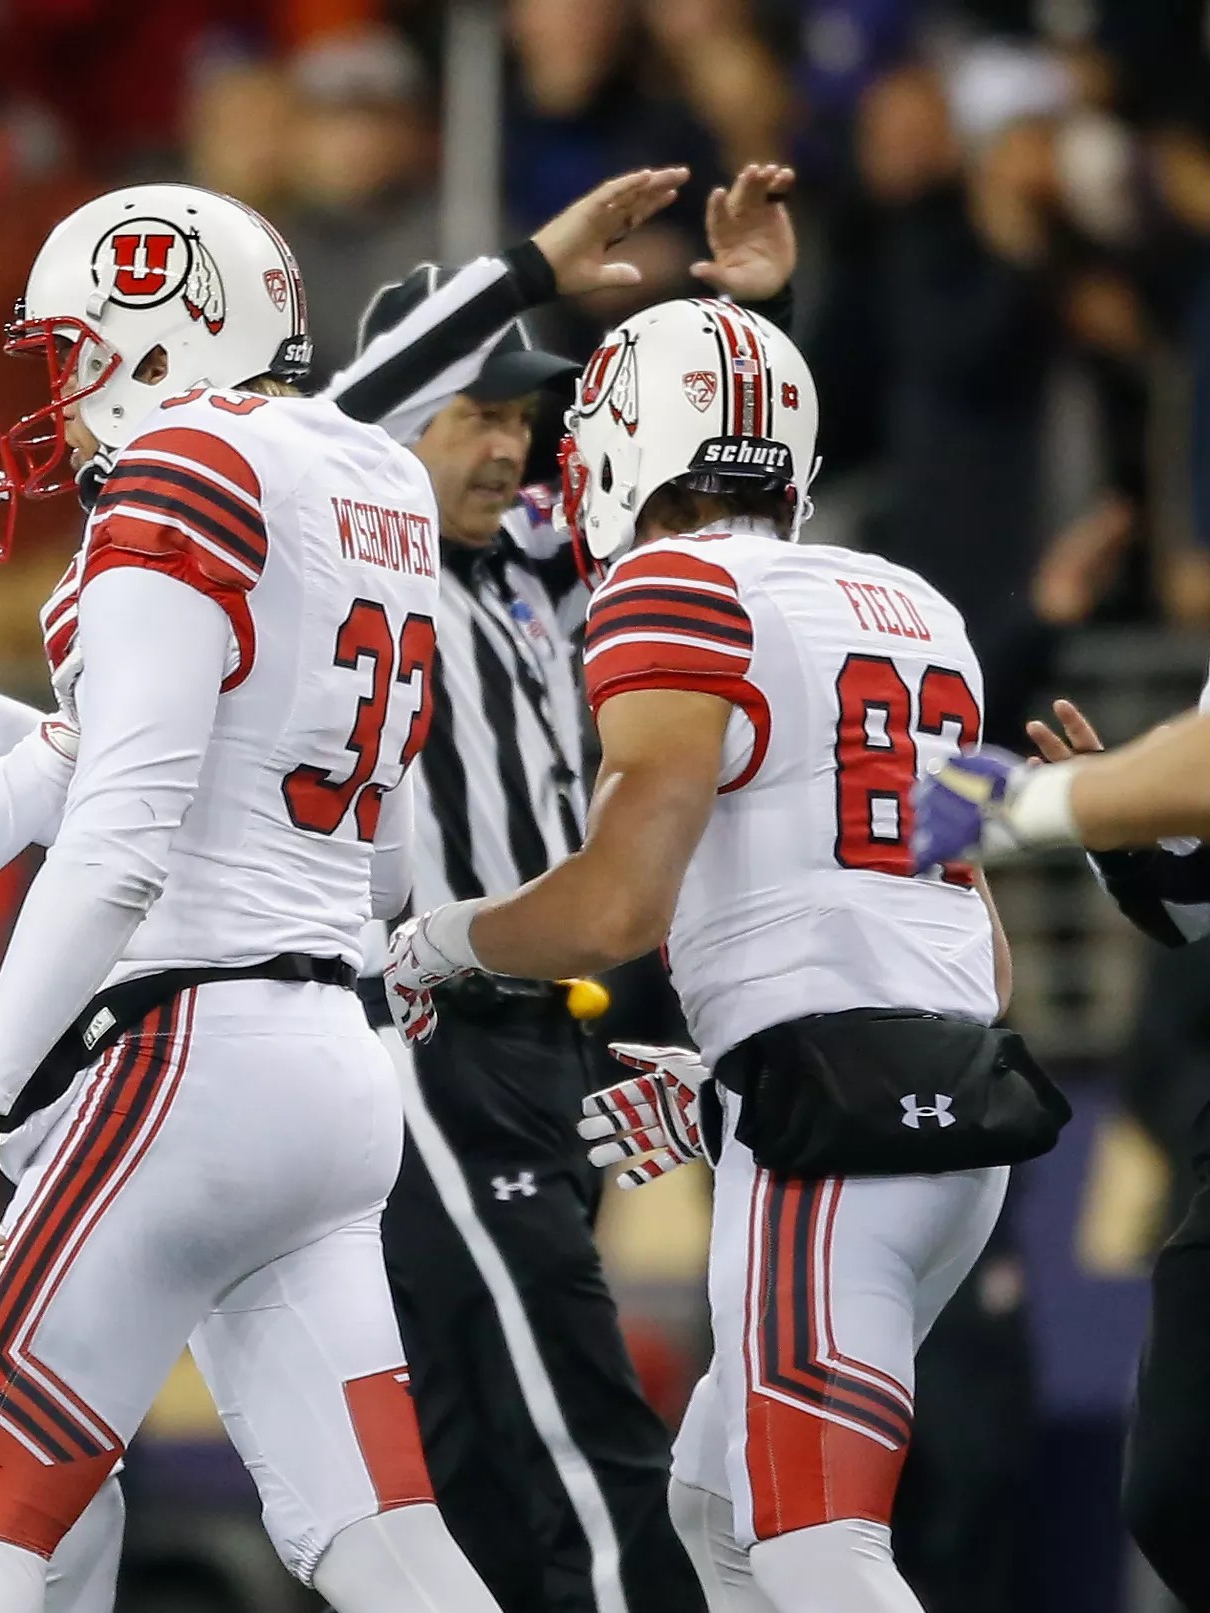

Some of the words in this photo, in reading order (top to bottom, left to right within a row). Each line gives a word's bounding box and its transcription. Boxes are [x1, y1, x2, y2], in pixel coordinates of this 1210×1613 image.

[112, 234, 175, 296] U
[582, 343, 622, 407] U
[704, 440, 788, 467] schutt
[835, 579, 932, 642] FIELD
[282, 598, 437, 844] 33
